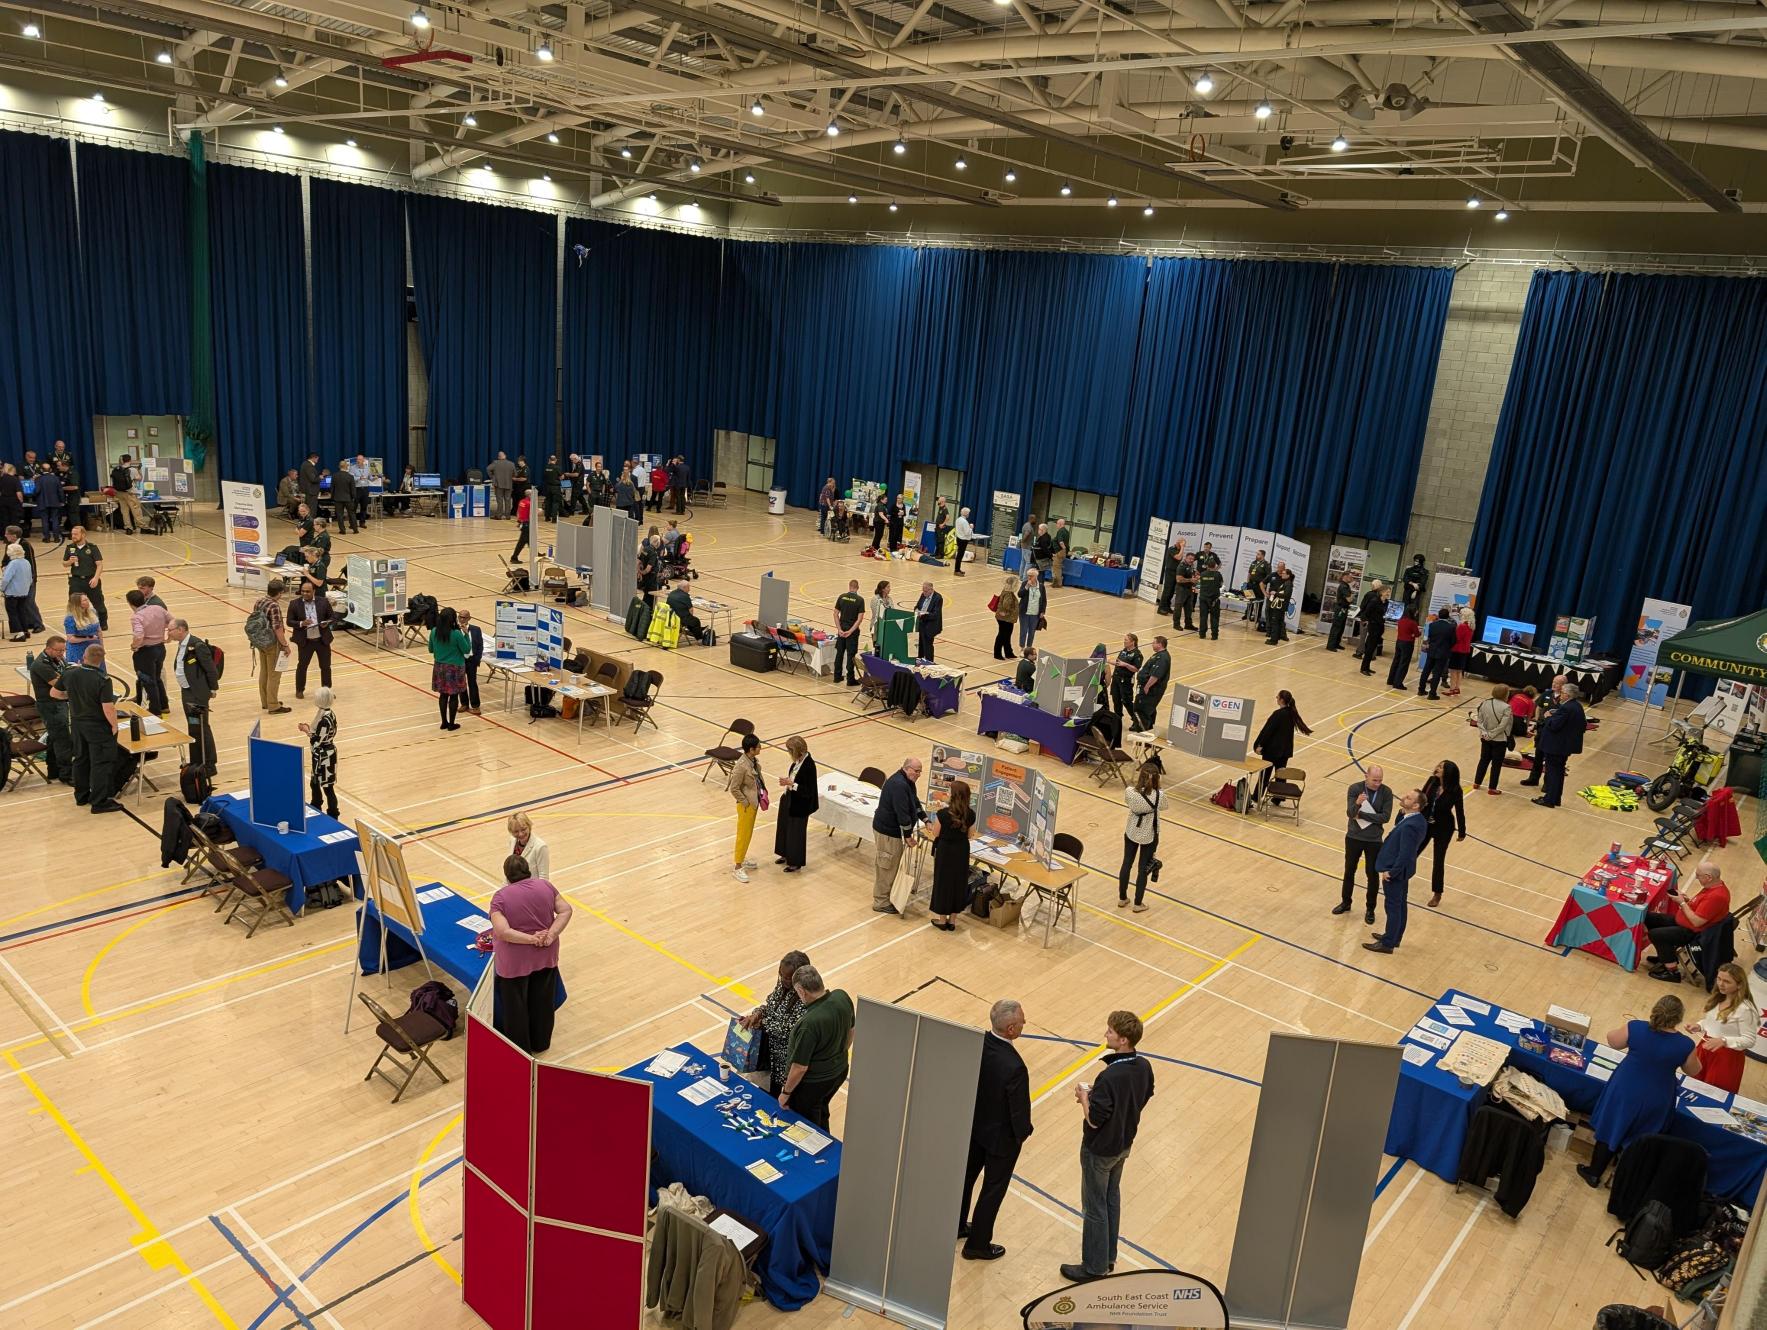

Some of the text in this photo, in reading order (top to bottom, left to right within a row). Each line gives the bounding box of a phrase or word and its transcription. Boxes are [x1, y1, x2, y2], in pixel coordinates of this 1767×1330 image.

[1208, 531, 1234, 540] Prevent
[1244, 535, 1269, 546] Prepare
[1670, 652, 1767, 679] COMMUNITY
[1221, 700, 1241, 710] GEN
[1125, 1293, 1143, 1301] East
[1173, 1288, 1200, 1299] NHS
[1086, 1302, 1169, 1310] Ambulance Service
